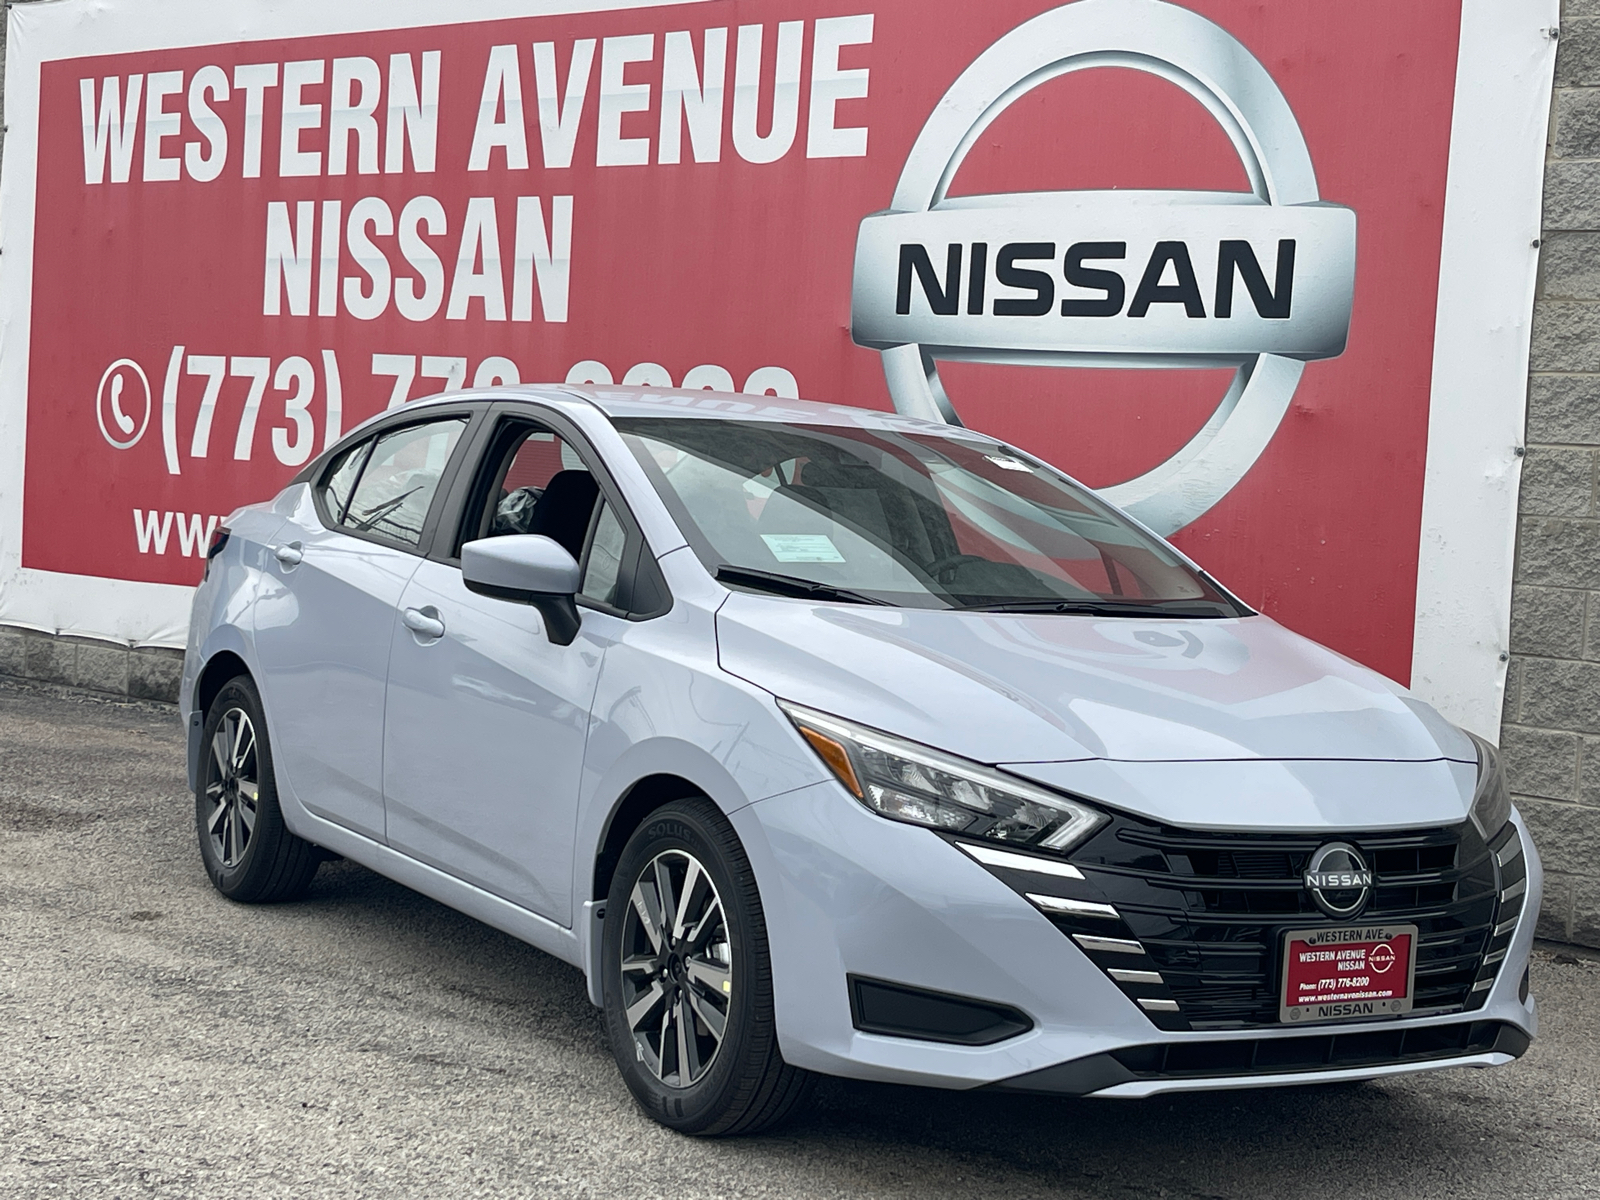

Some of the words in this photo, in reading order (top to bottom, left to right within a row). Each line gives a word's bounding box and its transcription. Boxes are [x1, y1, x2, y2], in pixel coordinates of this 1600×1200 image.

[80, 50, 442, 186] WESTERN
[467, 13, 875, 172] AVENUE
[262, 195, 575, 324] NISSAN
[896, 239, 1296, 319] NISSAN
[162, 345, 342, 475] (773)
[648, 822, 692, 842] SOLUS
[1306, 873, 1371, 886] NISSAN
[1316, 930, 1362, 942] WESTERN
[1299, 951, 1336, 962] WESTERN
[1336, 949, 1366, 960] AVENUE
[1337, 960, 1366, 971] NISSAN
[1317, 979, 1337, 991] (773)
[1337, 976, 1370, 988] 776-8200
[1318, 1002, 1373, 1017] NISSAN
